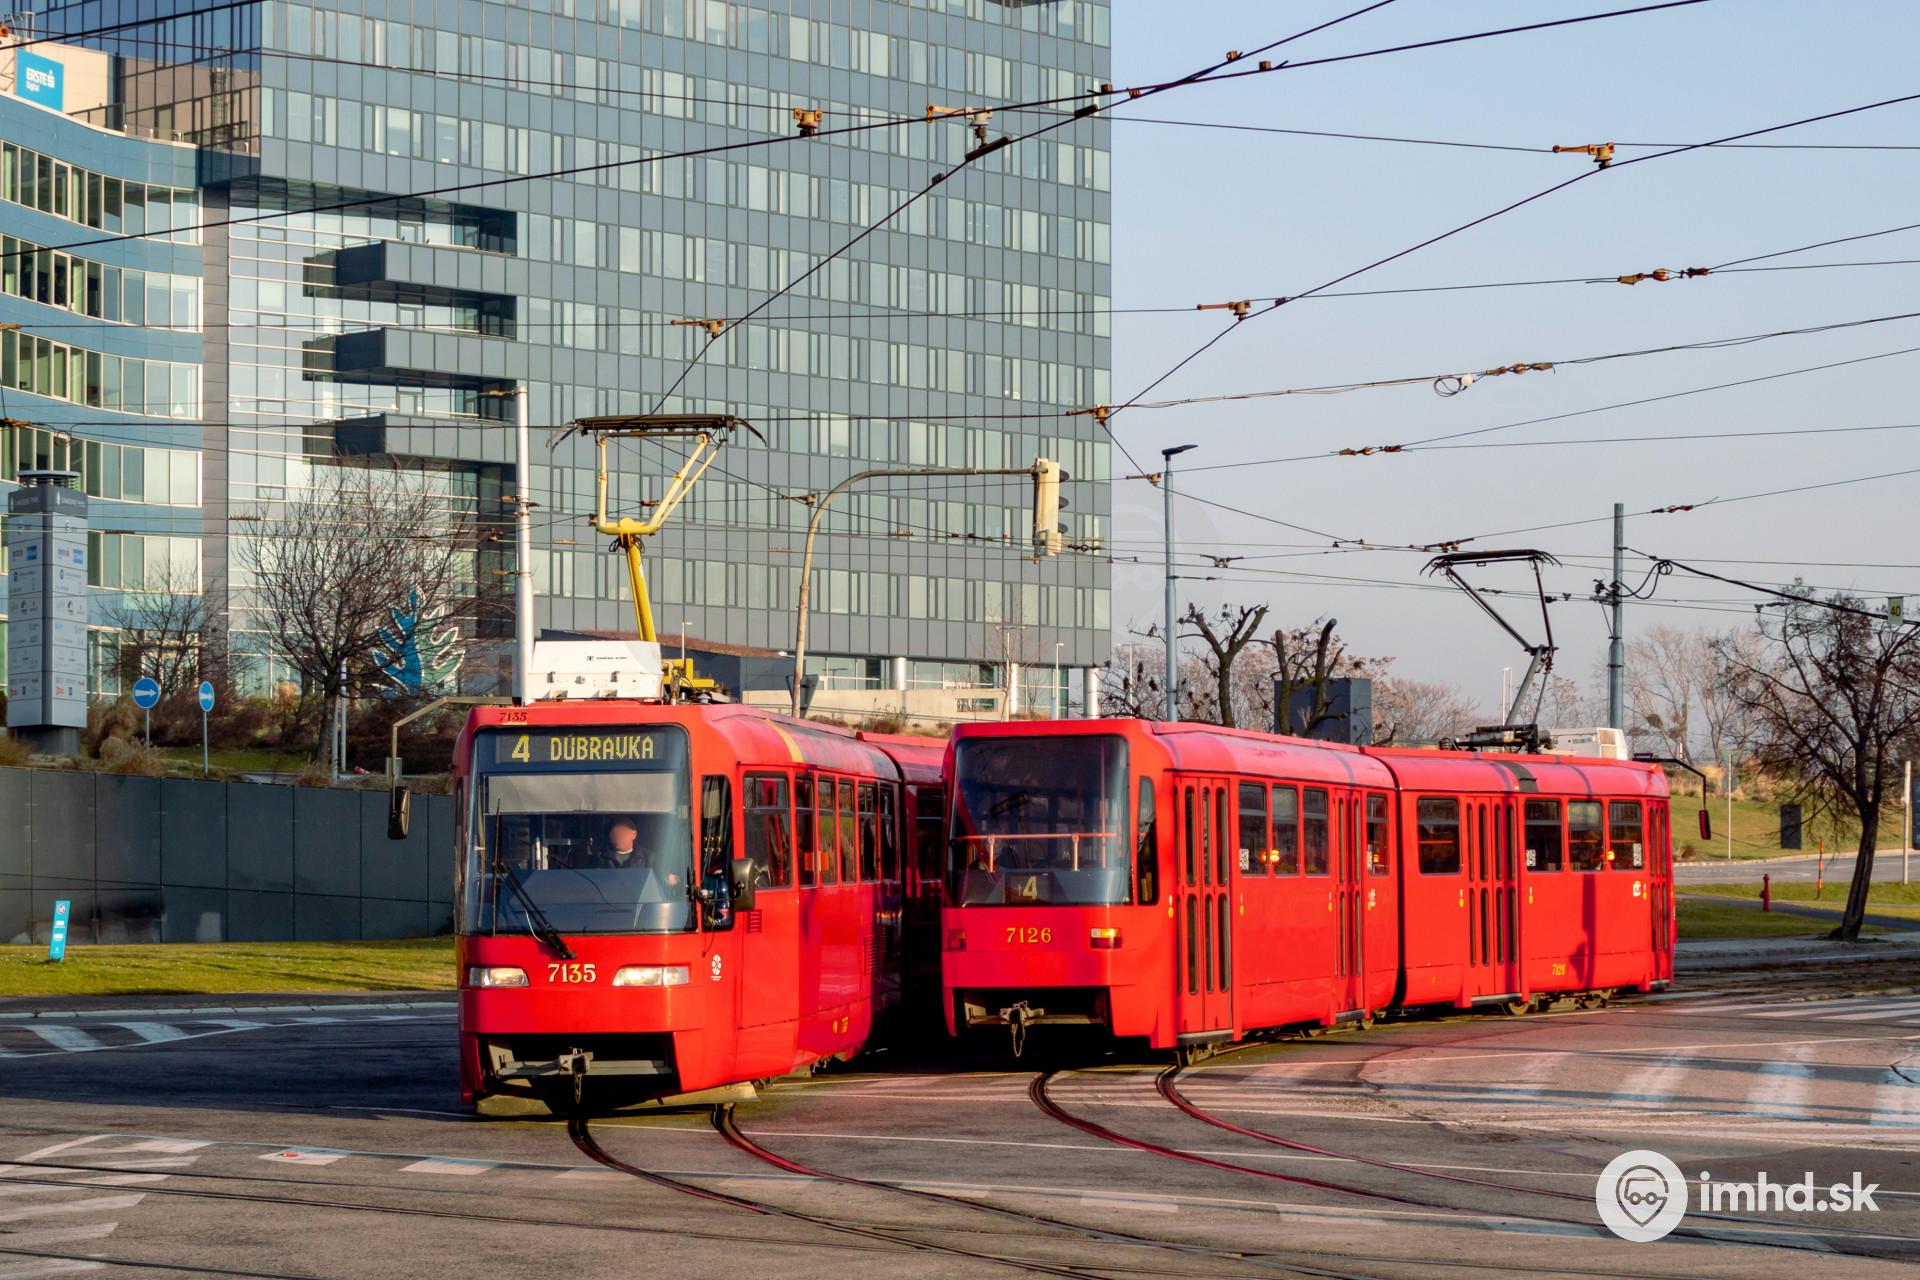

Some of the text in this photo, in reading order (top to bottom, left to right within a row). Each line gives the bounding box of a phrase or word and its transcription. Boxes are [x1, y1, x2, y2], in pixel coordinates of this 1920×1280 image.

[499, 711, 528, 723] 7135
[511, 733, 655, 763] 4 DÚBRAVKA
[1022, 875, 1038, 900] 4
[1006, 927, 1052, 943] 7126
[547, 963, 597, 983] 7135
